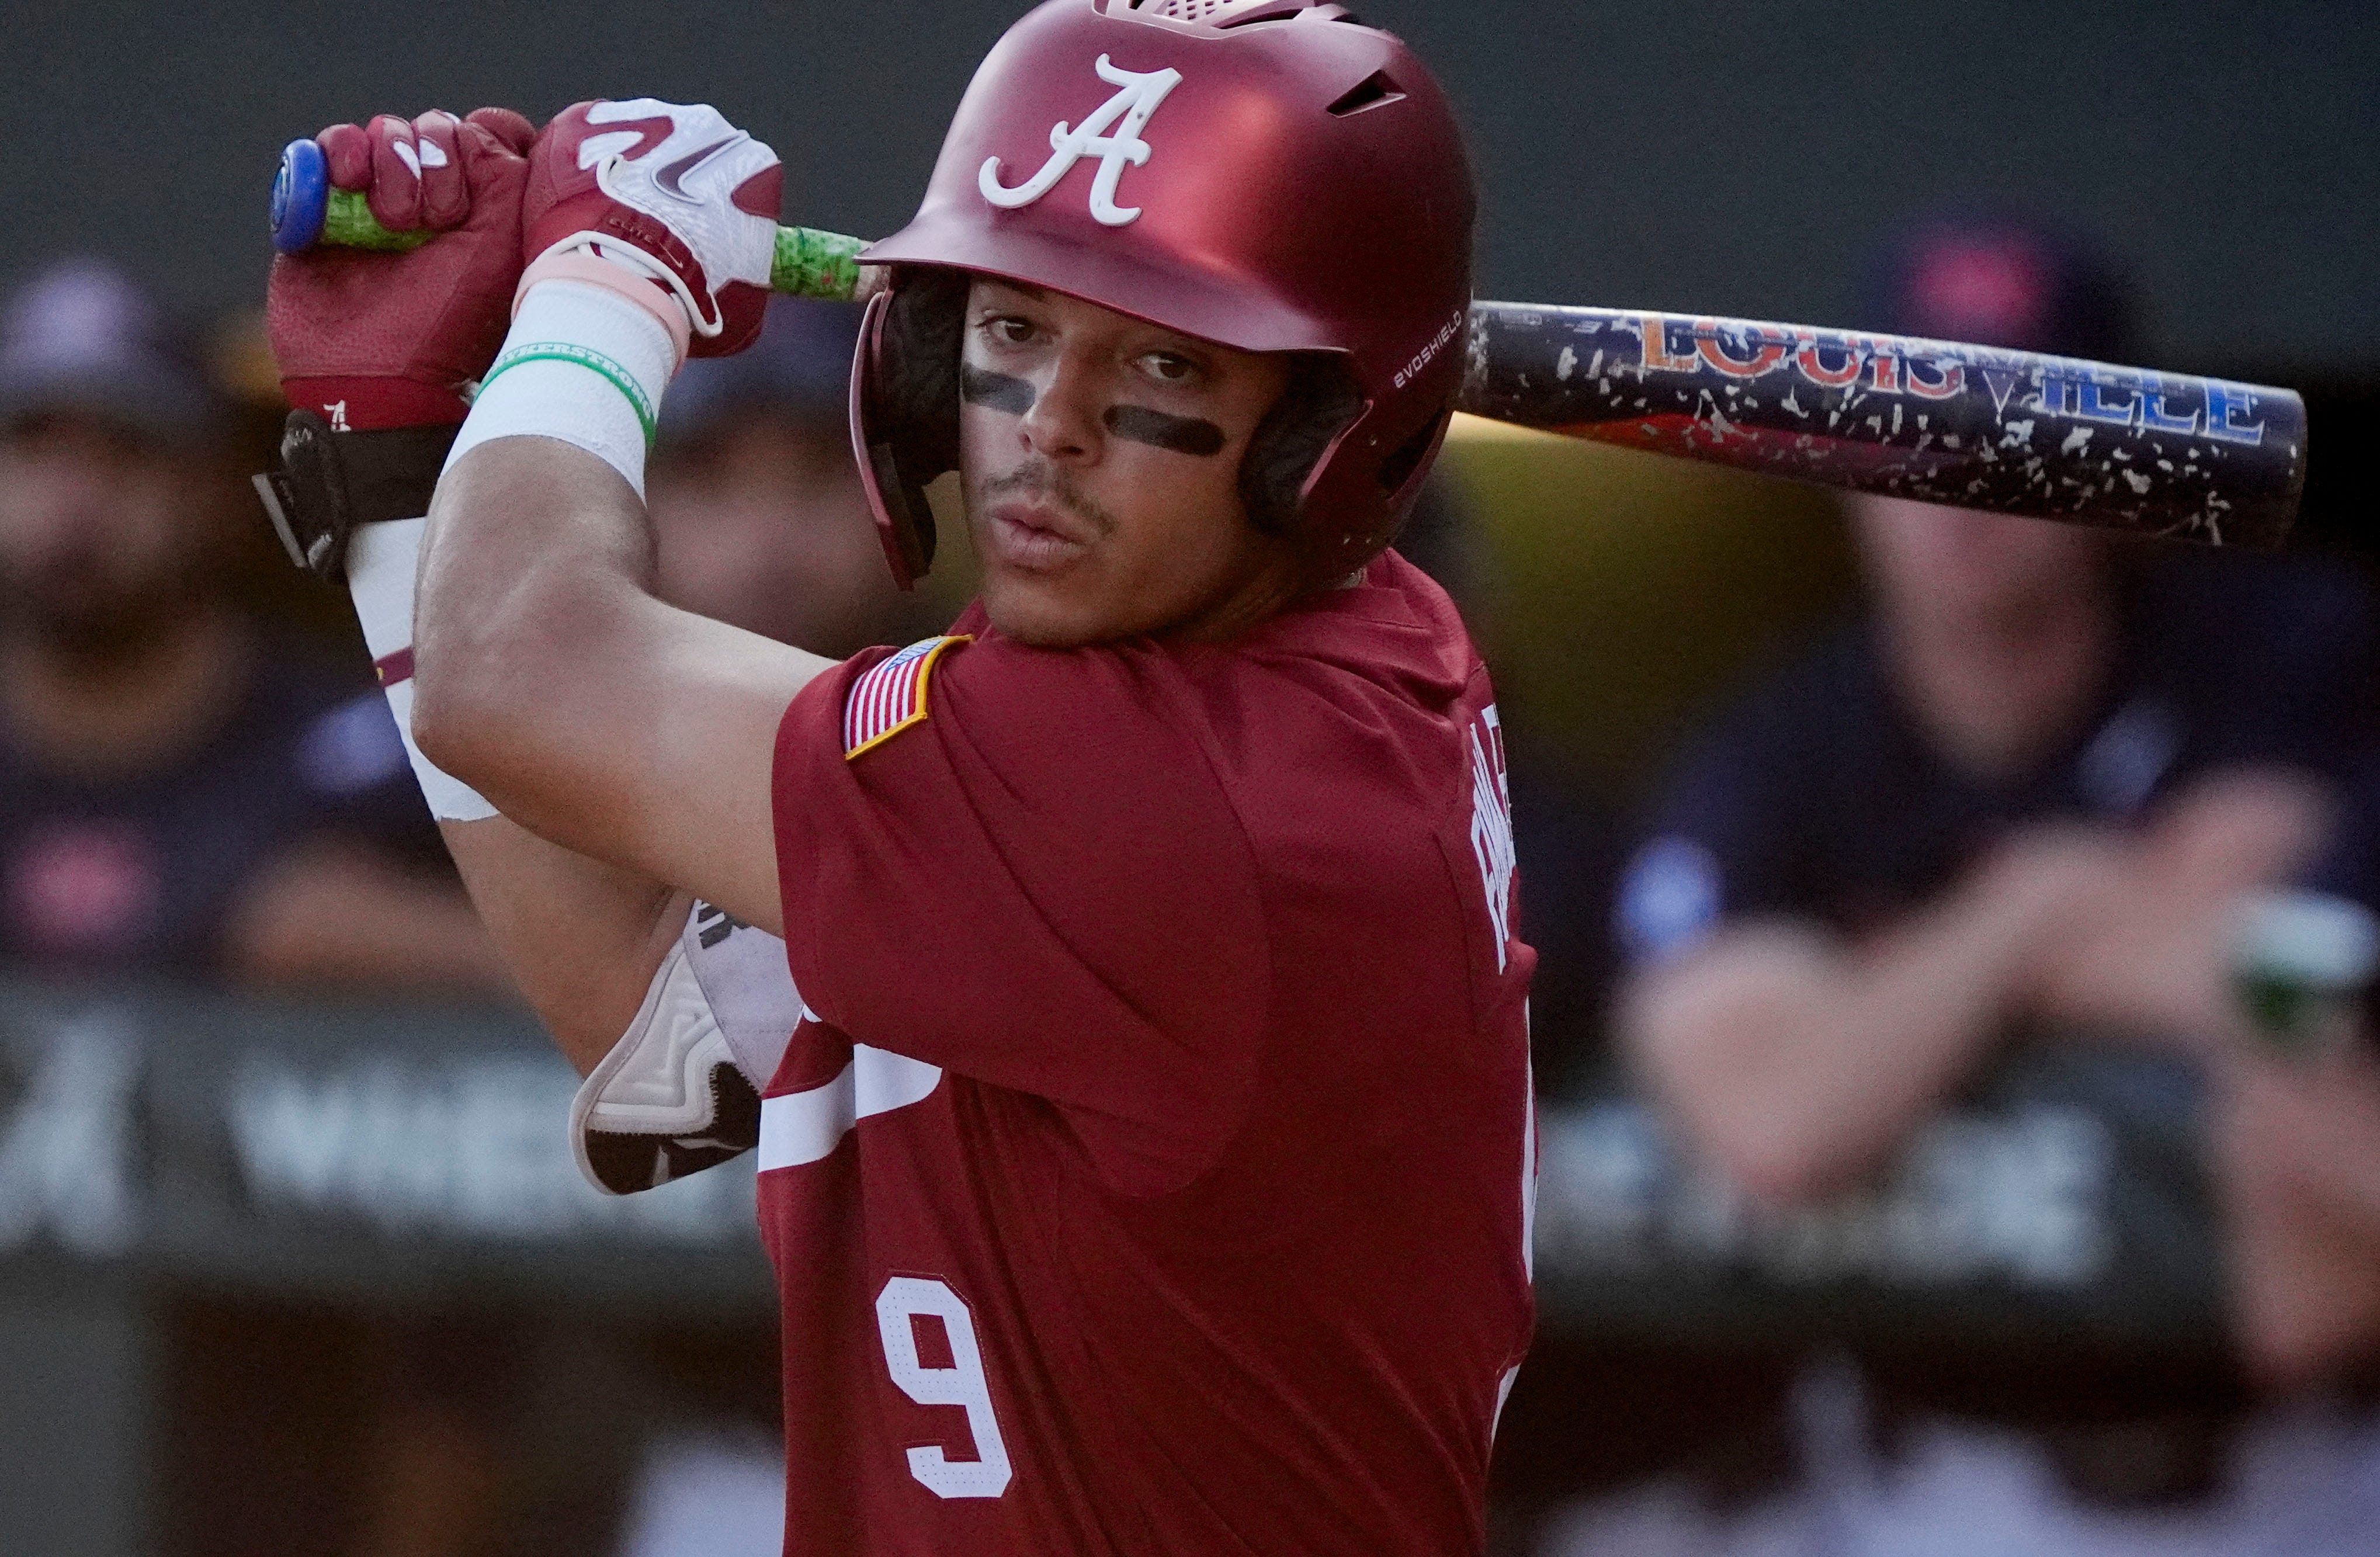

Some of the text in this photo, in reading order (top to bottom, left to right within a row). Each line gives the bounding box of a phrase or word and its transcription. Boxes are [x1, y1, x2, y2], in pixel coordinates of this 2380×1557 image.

[978, 53, 1183, 226] A
[1393, 310, 1462, 389] EVOSHIELD
[875, 1276, 1012, 1499] 9
